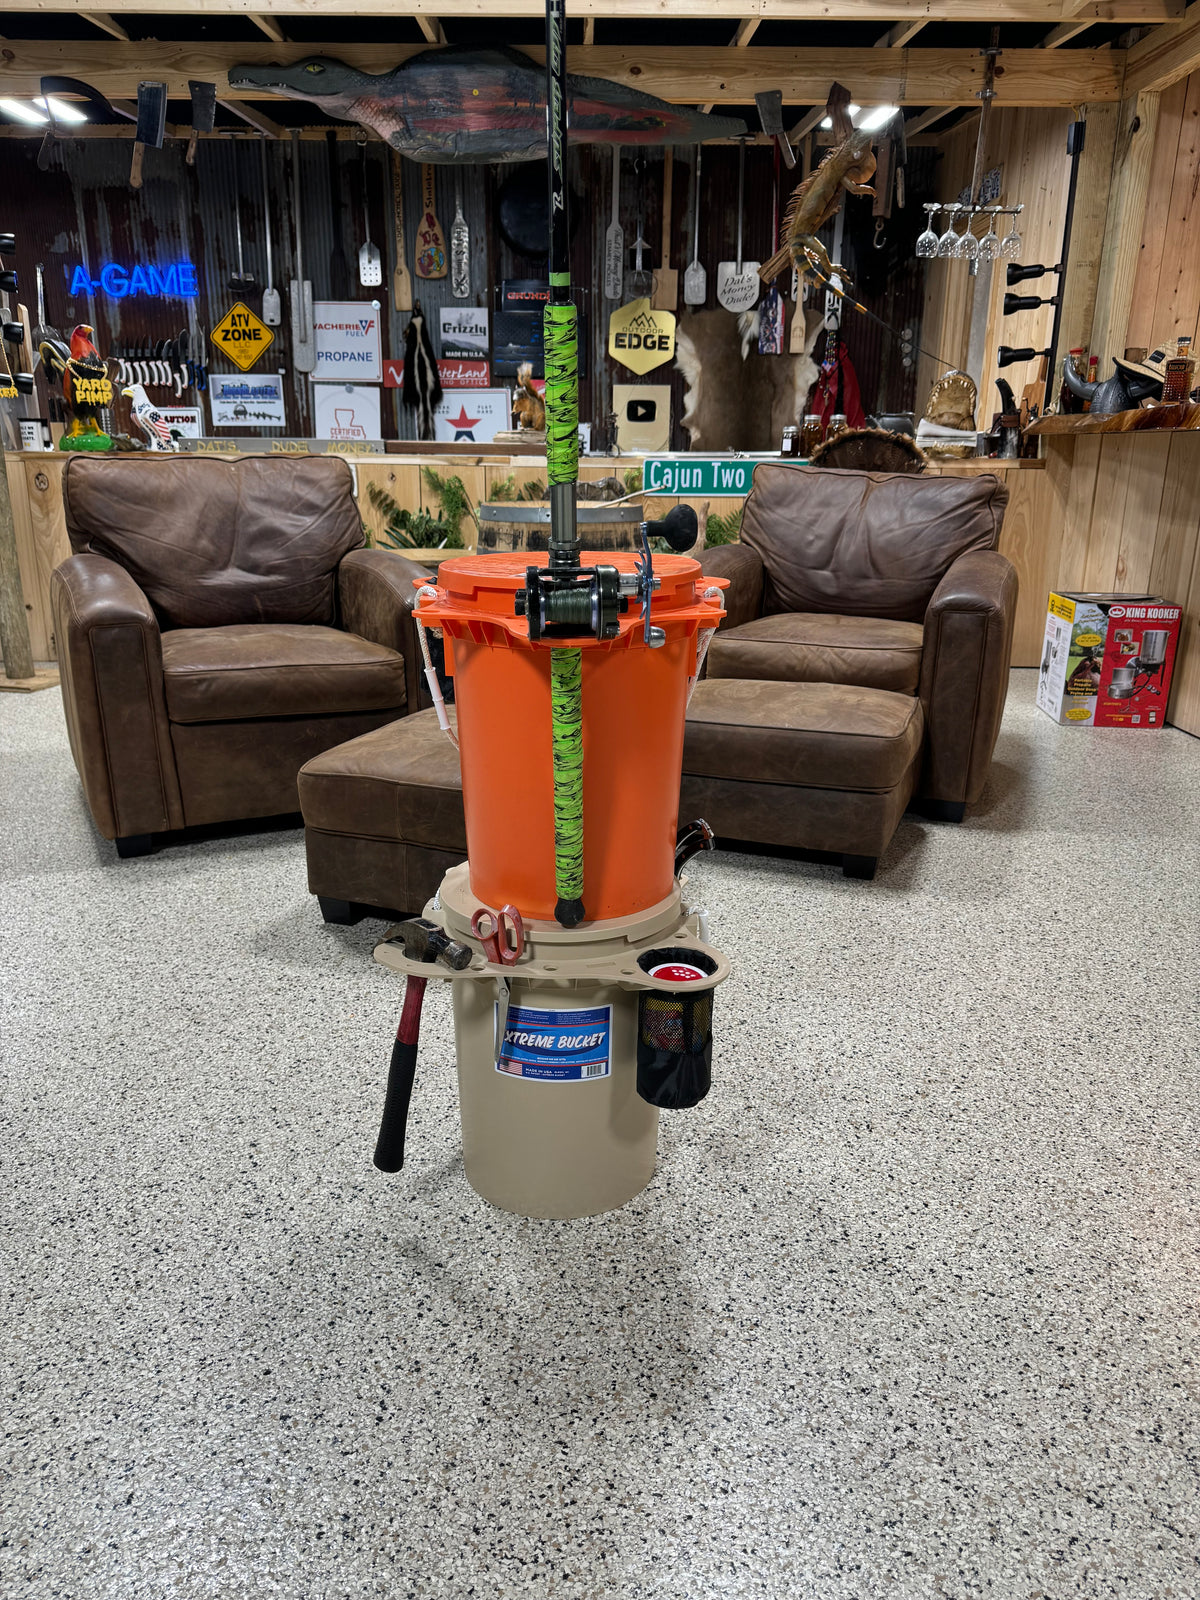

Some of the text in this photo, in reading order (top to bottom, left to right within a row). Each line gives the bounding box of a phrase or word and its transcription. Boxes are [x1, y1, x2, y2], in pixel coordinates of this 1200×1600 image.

[70, 262, 199, 298] A-GAME
[230, 313, 250, 327] ATV
[221, 328, 262, 341] ZONE
[442, 322, 487, 336] Grizzly
[622, 326, 664, 334] OUTDOOR
[614, 332, 670, 351] EDGE
[317, 351, 373, 362] PROPANE
[72, 378, 112, 391] YARD
[75, 390, 113, 406] PIMP
[163, 416, 197, 424] AUTION
[330, 427, 361, 437] CERTIFIED
[650, 461, 746, 493] Cajun Two
[1125, 608, 1180, 619] KING KOOKER
[557, 1031, 606, 1048] BUCKET
